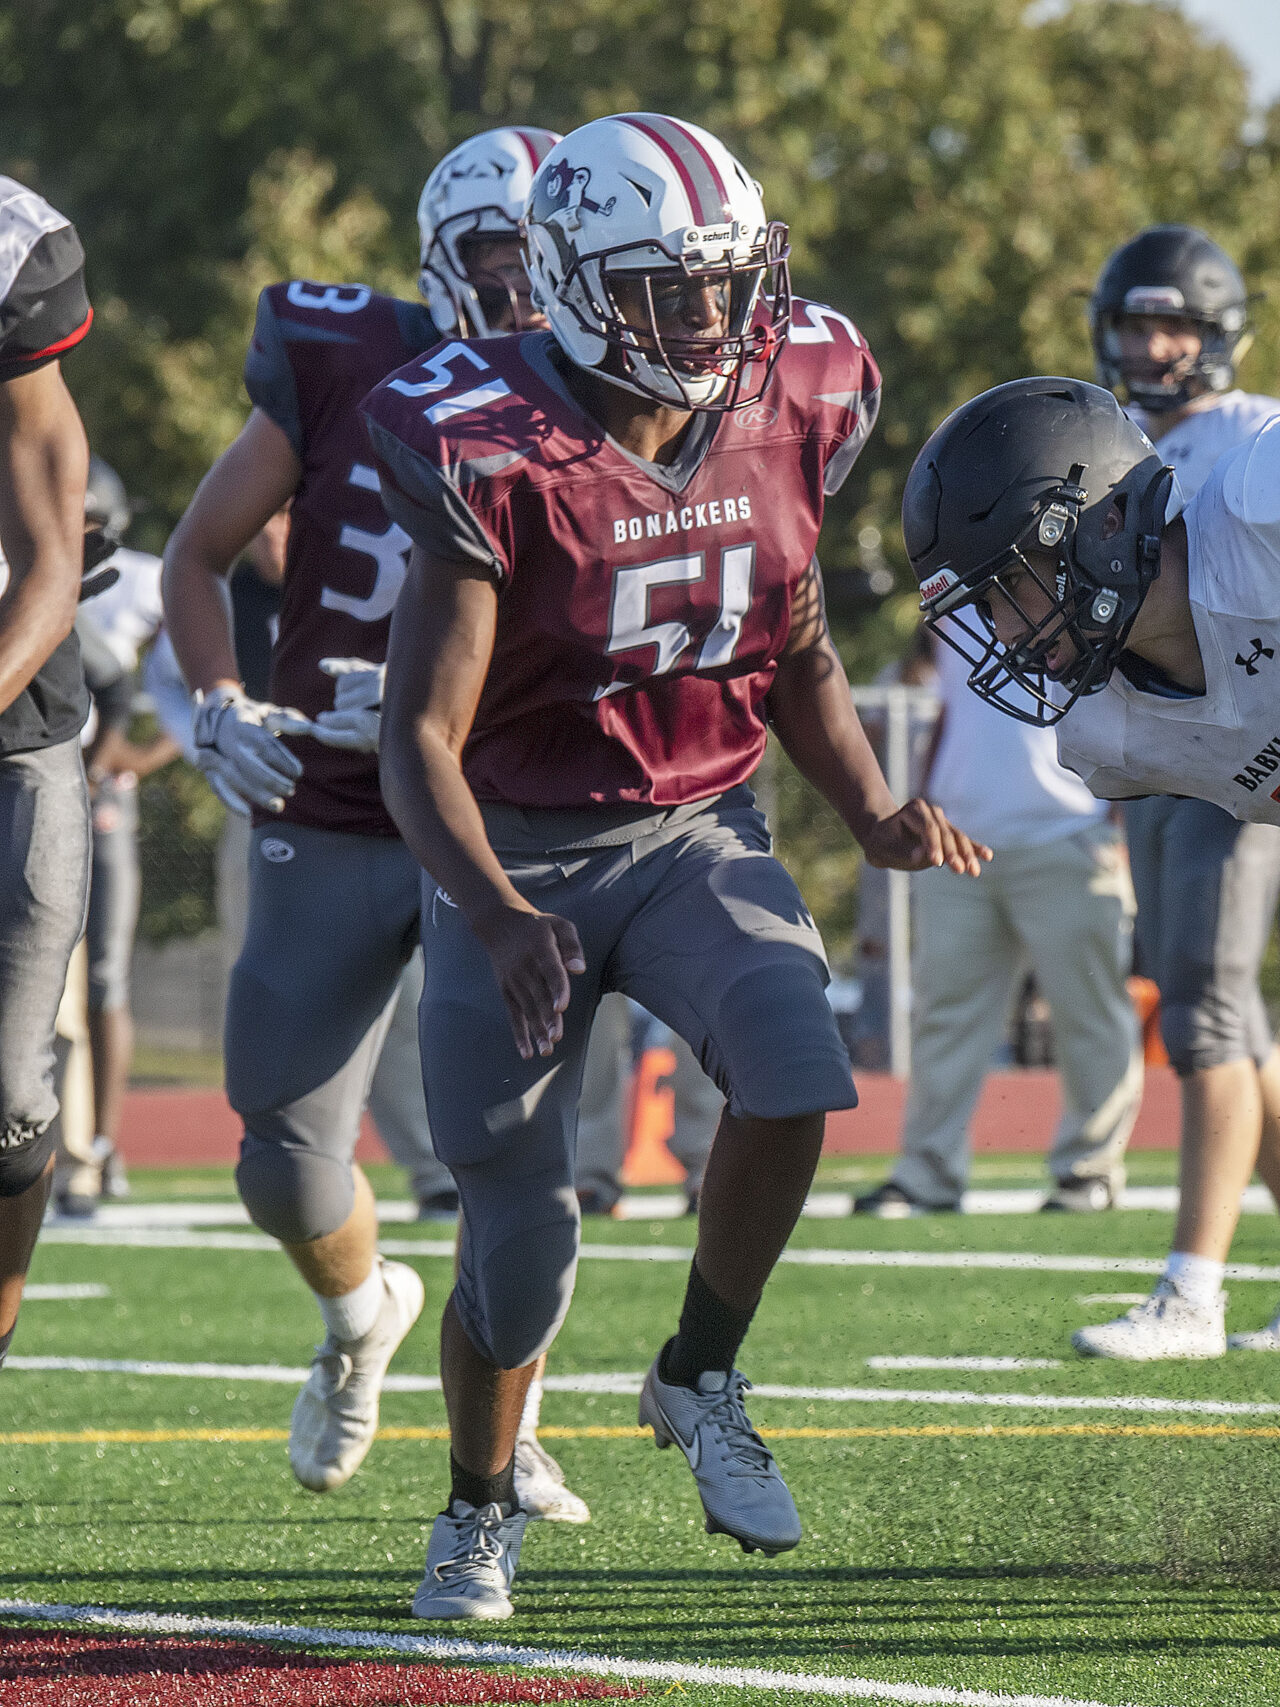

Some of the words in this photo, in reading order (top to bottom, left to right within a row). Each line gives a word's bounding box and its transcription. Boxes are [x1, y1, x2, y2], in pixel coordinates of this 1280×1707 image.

[703, 232, 730, 242] schutt
[757, 293, 862, 348] 5
[387, 341, 513, 425] 51
[613, 495, 752, 544] BONACKERS
[592, 540, 757, 702] 51
